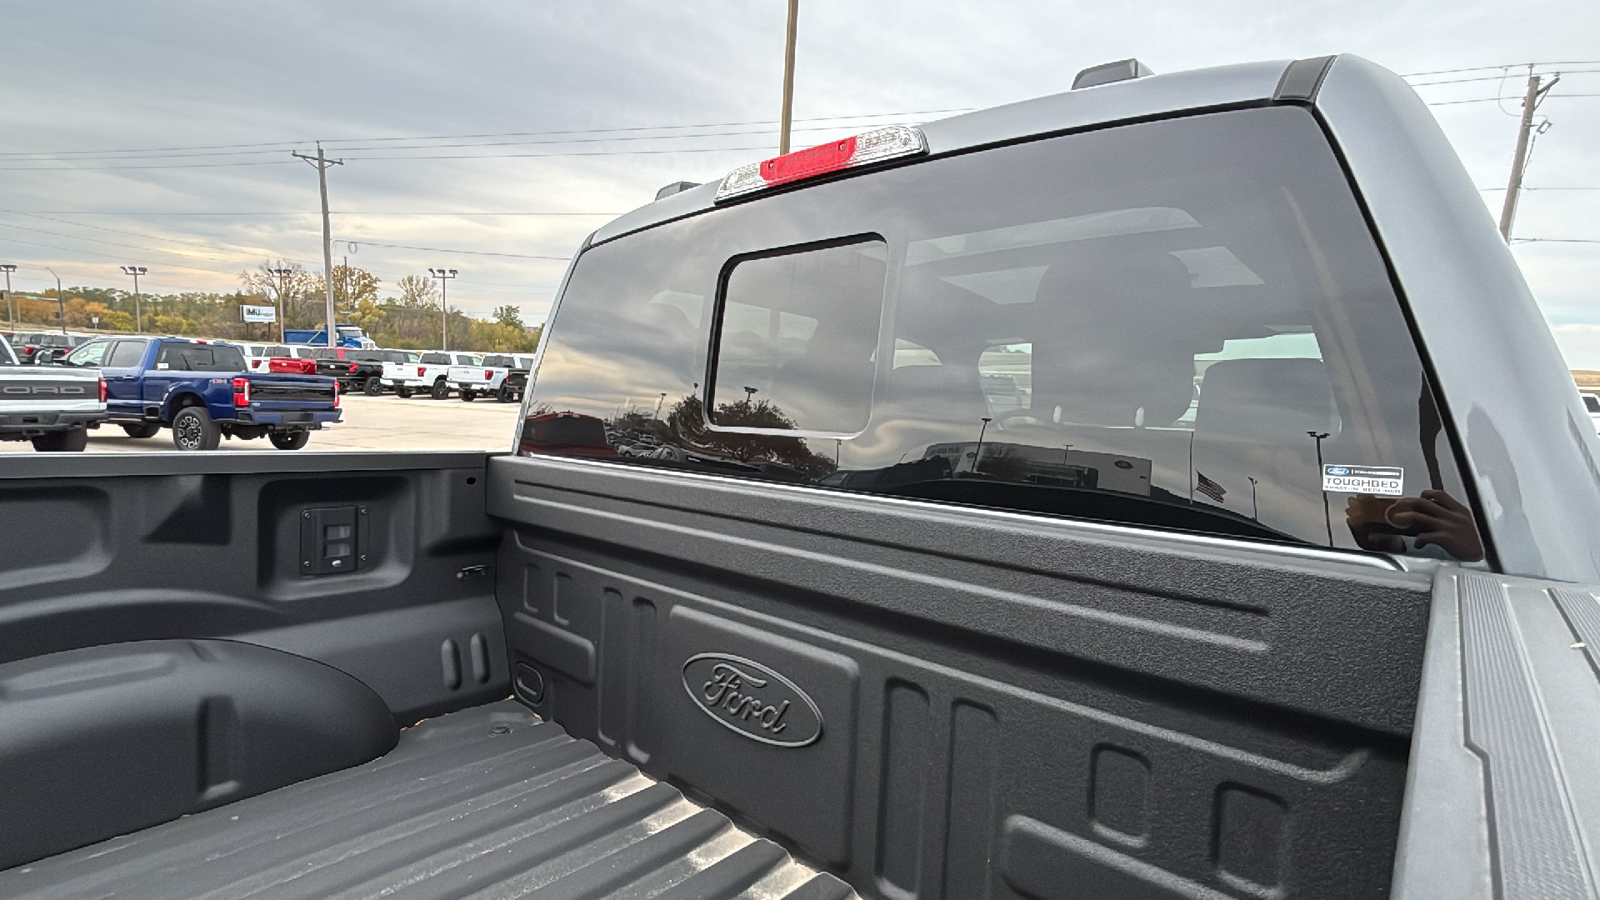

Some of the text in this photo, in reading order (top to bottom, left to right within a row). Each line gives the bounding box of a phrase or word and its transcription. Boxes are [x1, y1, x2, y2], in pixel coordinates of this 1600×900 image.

[0, 386, 85, 394] ORD
[1325, 477, 1399, 489] TOUGHBED
[703, 663, 790, 733] Ford
